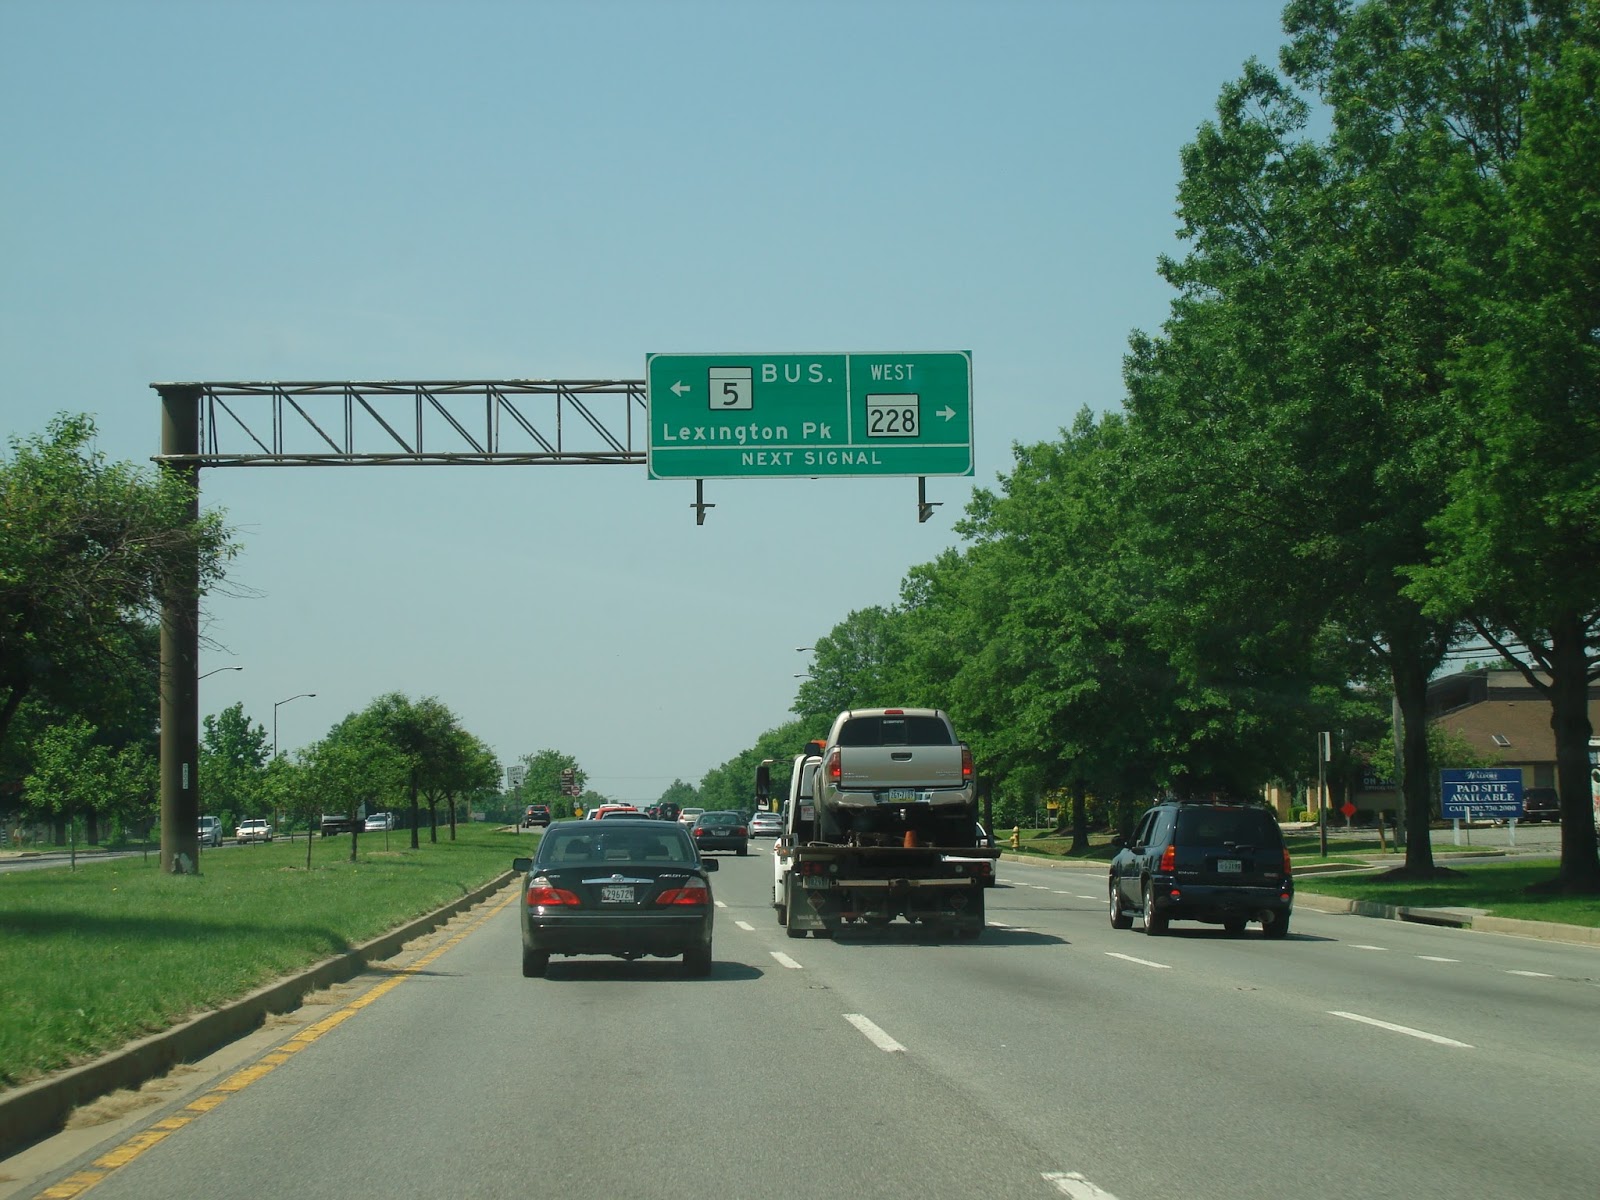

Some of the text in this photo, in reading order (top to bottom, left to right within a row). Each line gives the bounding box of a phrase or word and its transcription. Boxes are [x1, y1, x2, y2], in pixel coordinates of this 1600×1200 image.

[762, 363, 833, 383] BUS.
[870, 364, 914, 381] WEST
[722, 382, 739, 406] 5
[870, 408, 915, 433] 228
[663, 422, 832, 445] Lexington Pk
[742, 451, 882, 466] NEXT SIGNAL
[1450, 793, 1515, 802] AVAILABLE
[1456, 784, 1508, 793] PAD SITE
